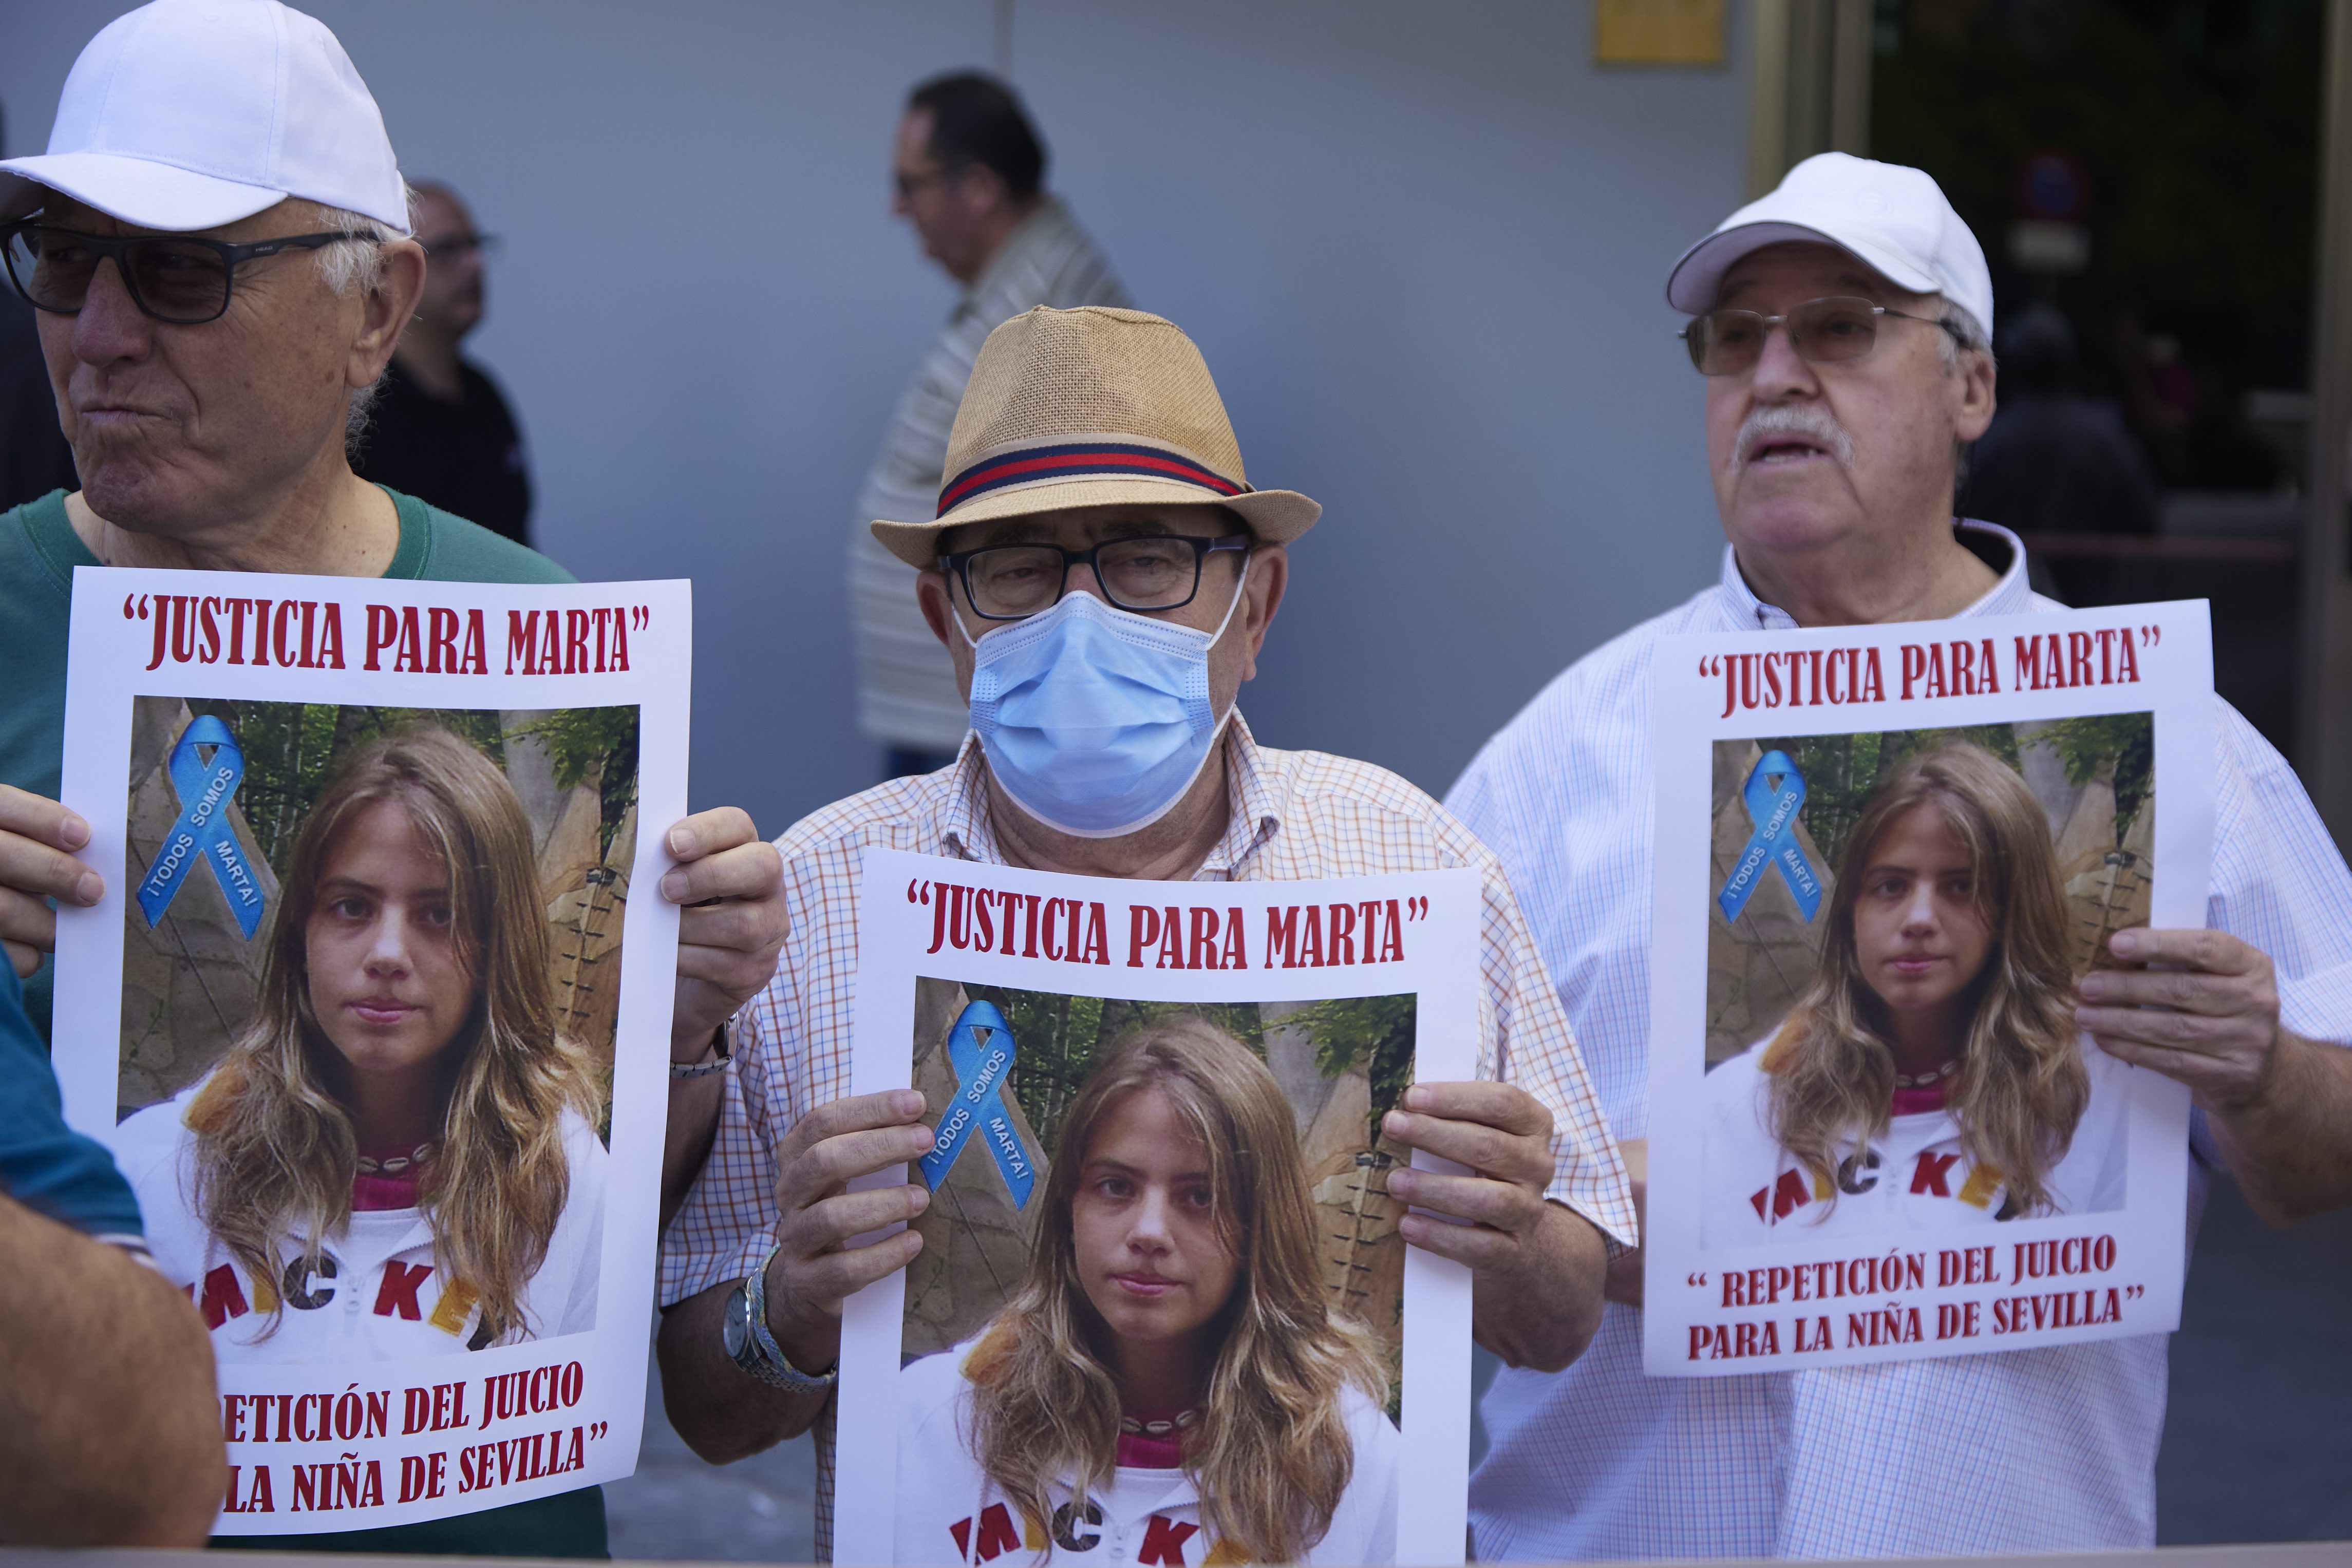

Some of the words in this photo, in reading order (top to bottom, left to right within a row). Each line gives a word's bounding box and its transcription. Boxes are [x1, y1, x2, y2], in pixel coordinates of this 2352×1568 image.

[123, 593, 345, 671] “JUSTICIA
[363, 604, 487, 675] PARA
[504, 605, 649, 675] MARTA”
[1699, 646, 1887, 719] “JUSTICIA
[1900, 638, 2001, 700] PARA
[2014, 625, 2161, 691] MARTA”
[146, 833, 193, 897] ¡TODOS
[191, 767, 234, 827] SOMOS
[1727, 846, 1765, 899] ¡TODOS
[1763, 791, 1798, 841] SOMOS
[1783, 848, 1818, 898] MARTA!
[215, 840, 257, 907] MARTA!
[907, 878, 1111, 966] “JUSTICIA
[1126, 905, 1248, 970] PARA
[1264, 896, 1428, 969] MARTA”
[928, 1108, 970, 1165] ¡TODOS
[967, 1049, 1006, 1104] SOMOS
[989, 1117, 1029, 1180] MARTA!
[1721, 1249, 1926, 1307] REPETICIÓN
[1938, 1245, 2000, 1288] DEL
[2011, 1234, 2117, 1286] JUICIO
[1688, 1320, 1781, 1361] PARA
[1794, 1316, 1835, 1353] LA
[1847, 1301, 1925, 1348] NIÑA
[1937, 1301, 1982, 1340] DE
[1993, 1284, 2145, 1334] SEVILLA”
[219, 1384, 390, 1442] ETICIÓN
[401, 1382, 469, 1435] DEL
[478, 1361, 583, 1430] JUICIO
[223, 1465, 275, 1513] LA
[290, 1452, 384, 1512] NIÑA
[398, 1452, 446, 1504] DE
[459, 1421, 608, 1494] SEVILLA”
